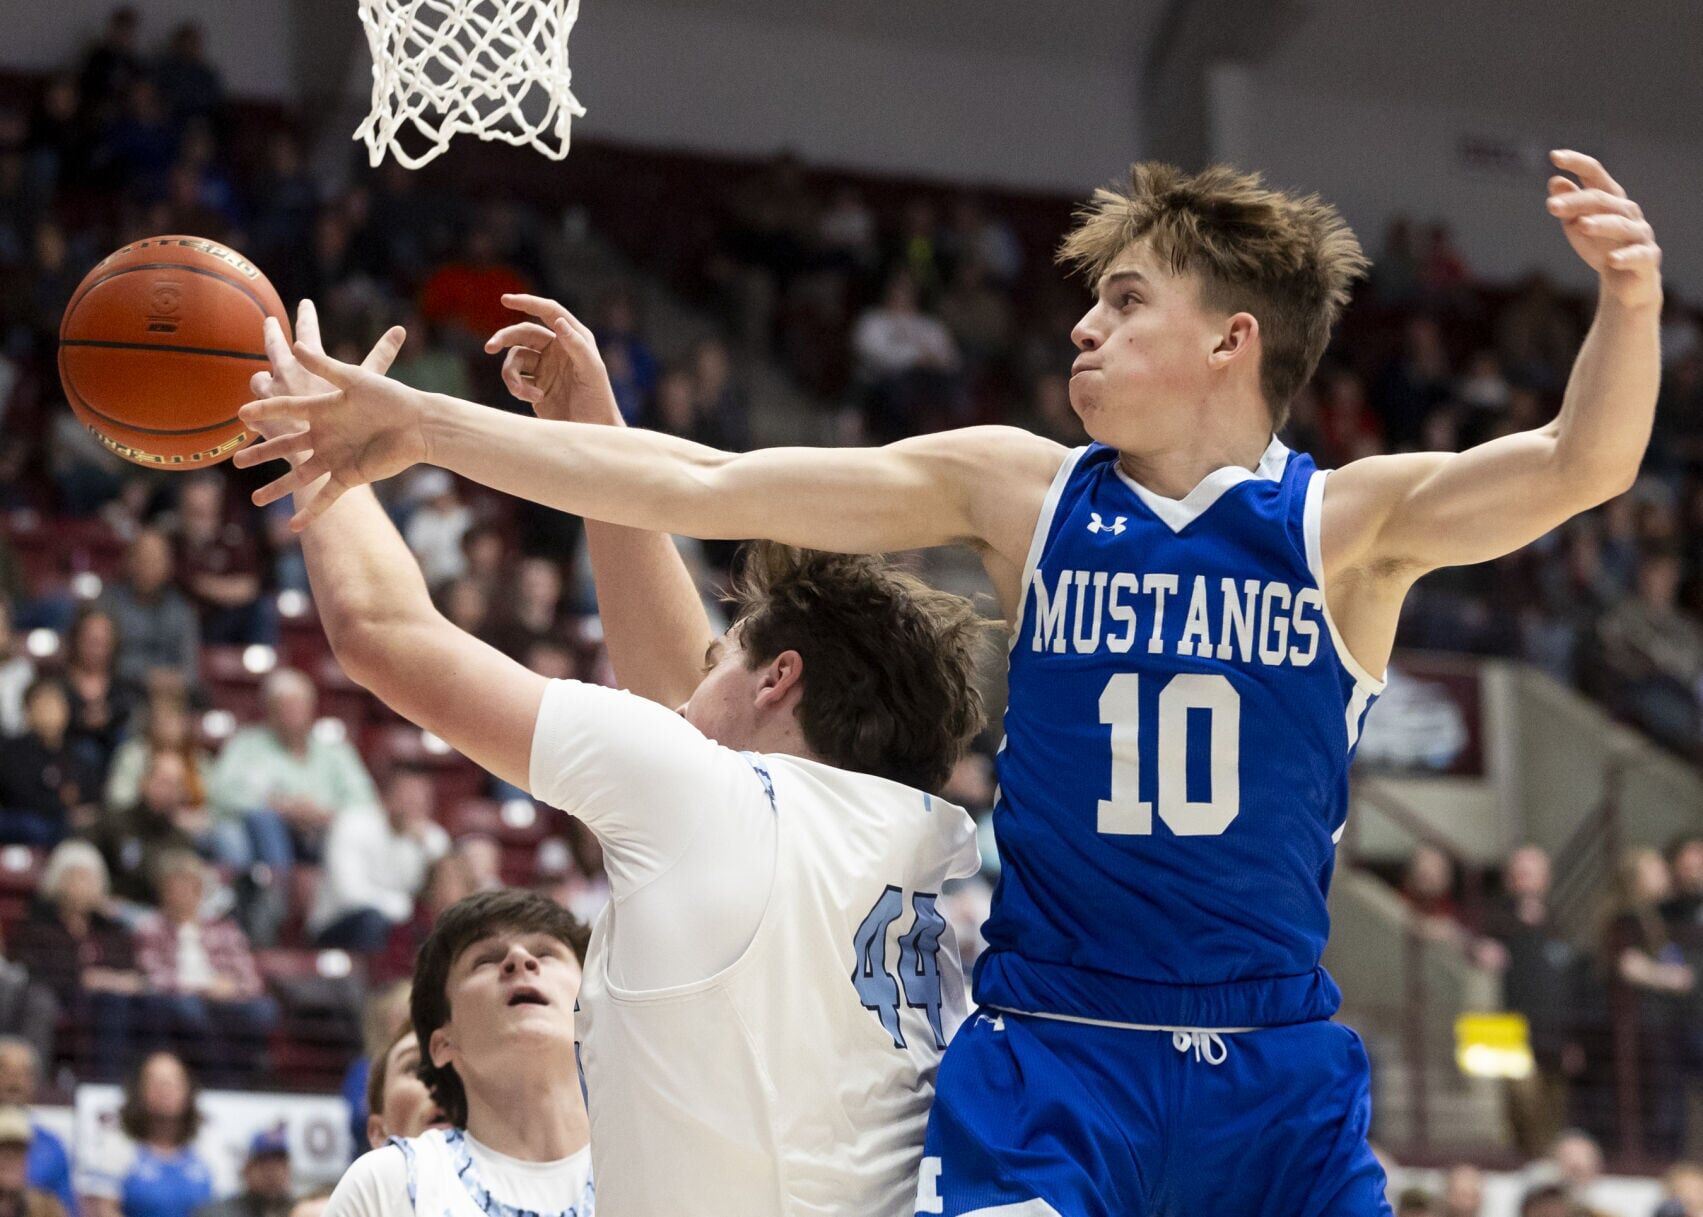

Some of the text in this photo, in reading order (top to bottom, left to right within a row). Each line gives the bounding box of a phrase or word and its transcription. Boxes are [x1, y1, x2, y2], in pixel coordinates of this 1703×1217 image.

[1032, 569, 1322, 666] MUSTANGS
[1097, 673, 1240, 836] 10
[851, 884, 947, 1049] 44
